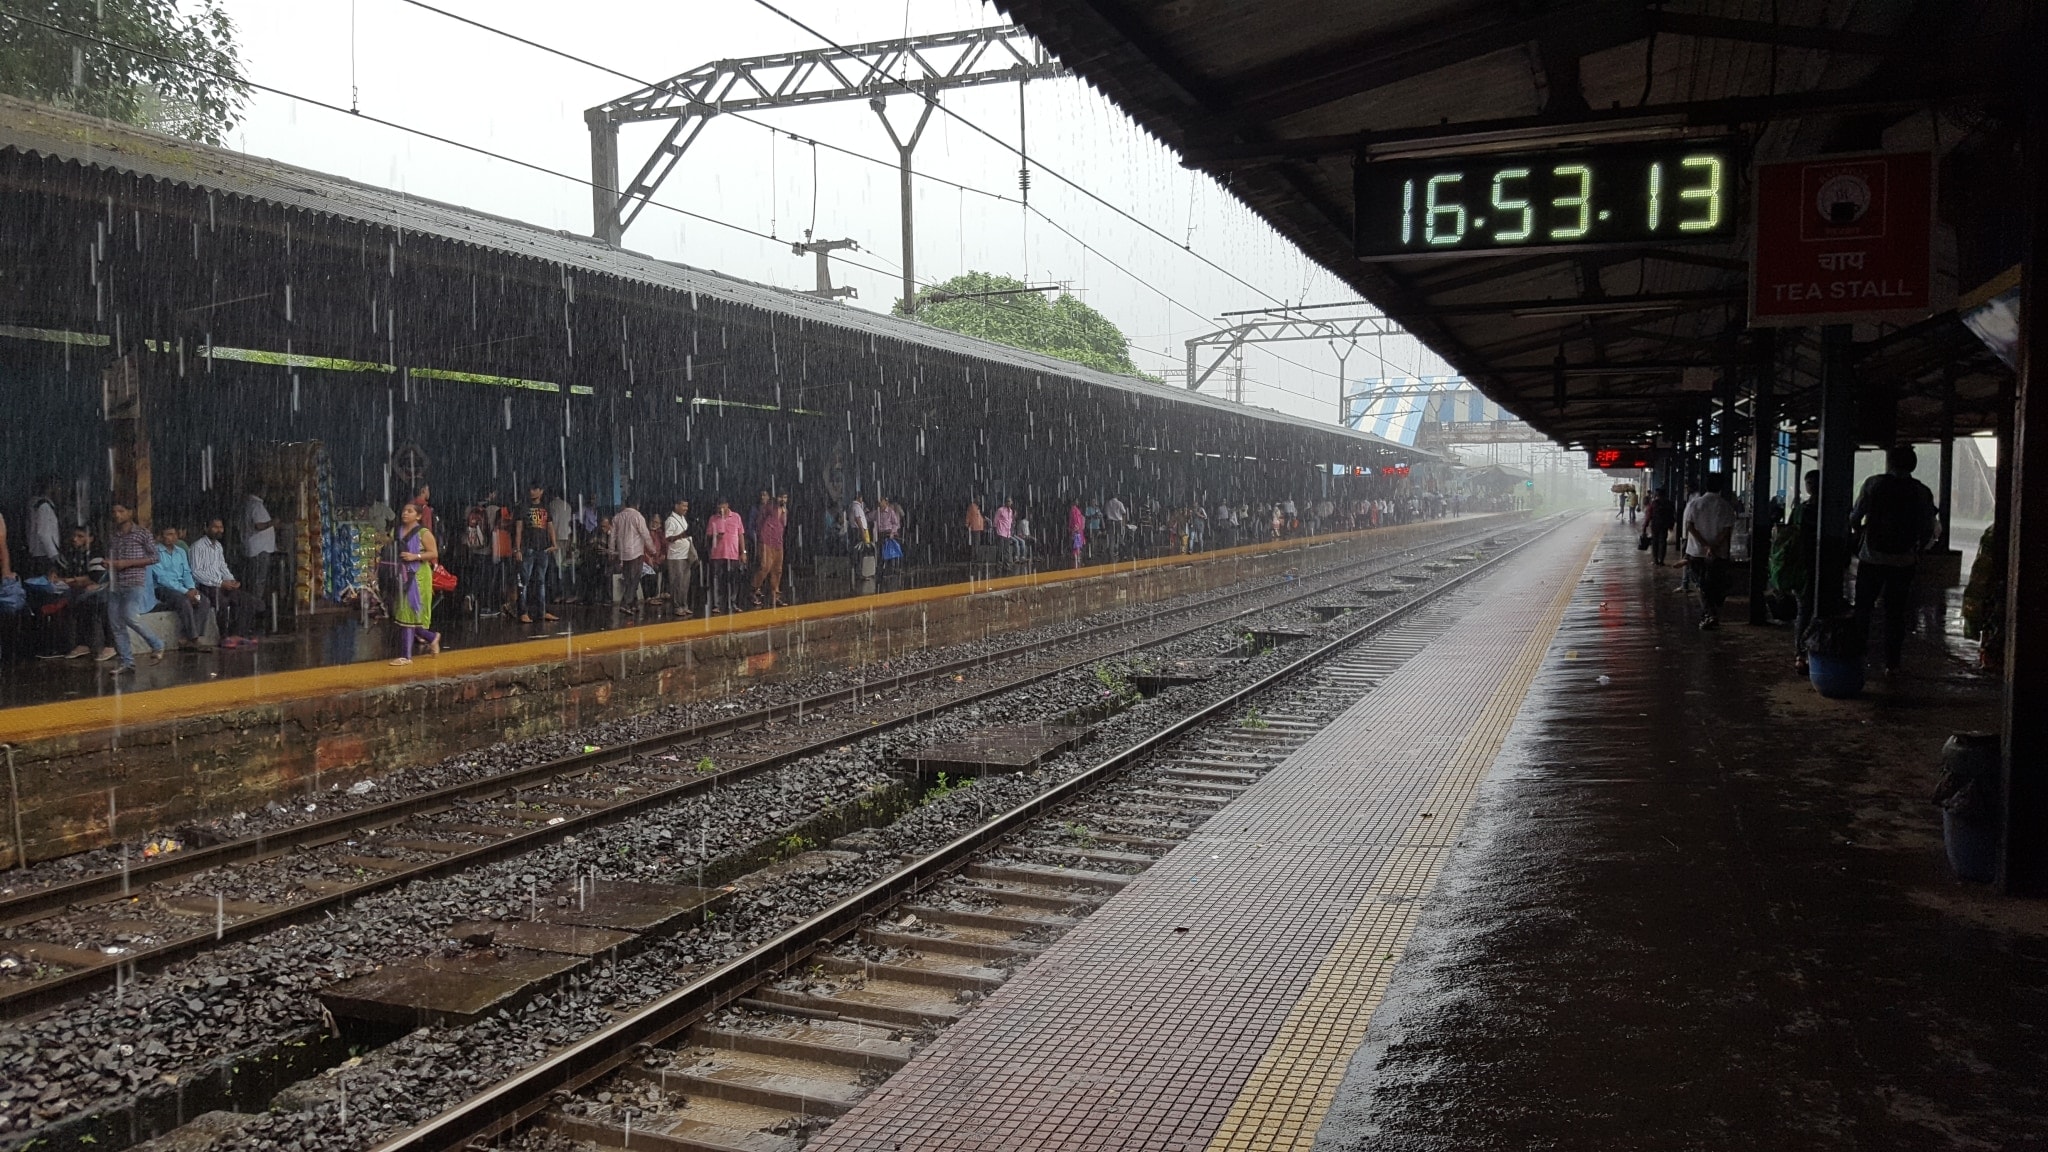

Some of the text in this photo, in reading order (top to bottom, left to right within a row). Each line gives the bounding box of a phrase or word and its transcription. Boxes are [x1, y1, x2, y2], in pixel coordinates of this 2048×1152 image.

[1818, 251, 1867, 271] चाय
[1774, 279, 1913, 302] TEA STALL
